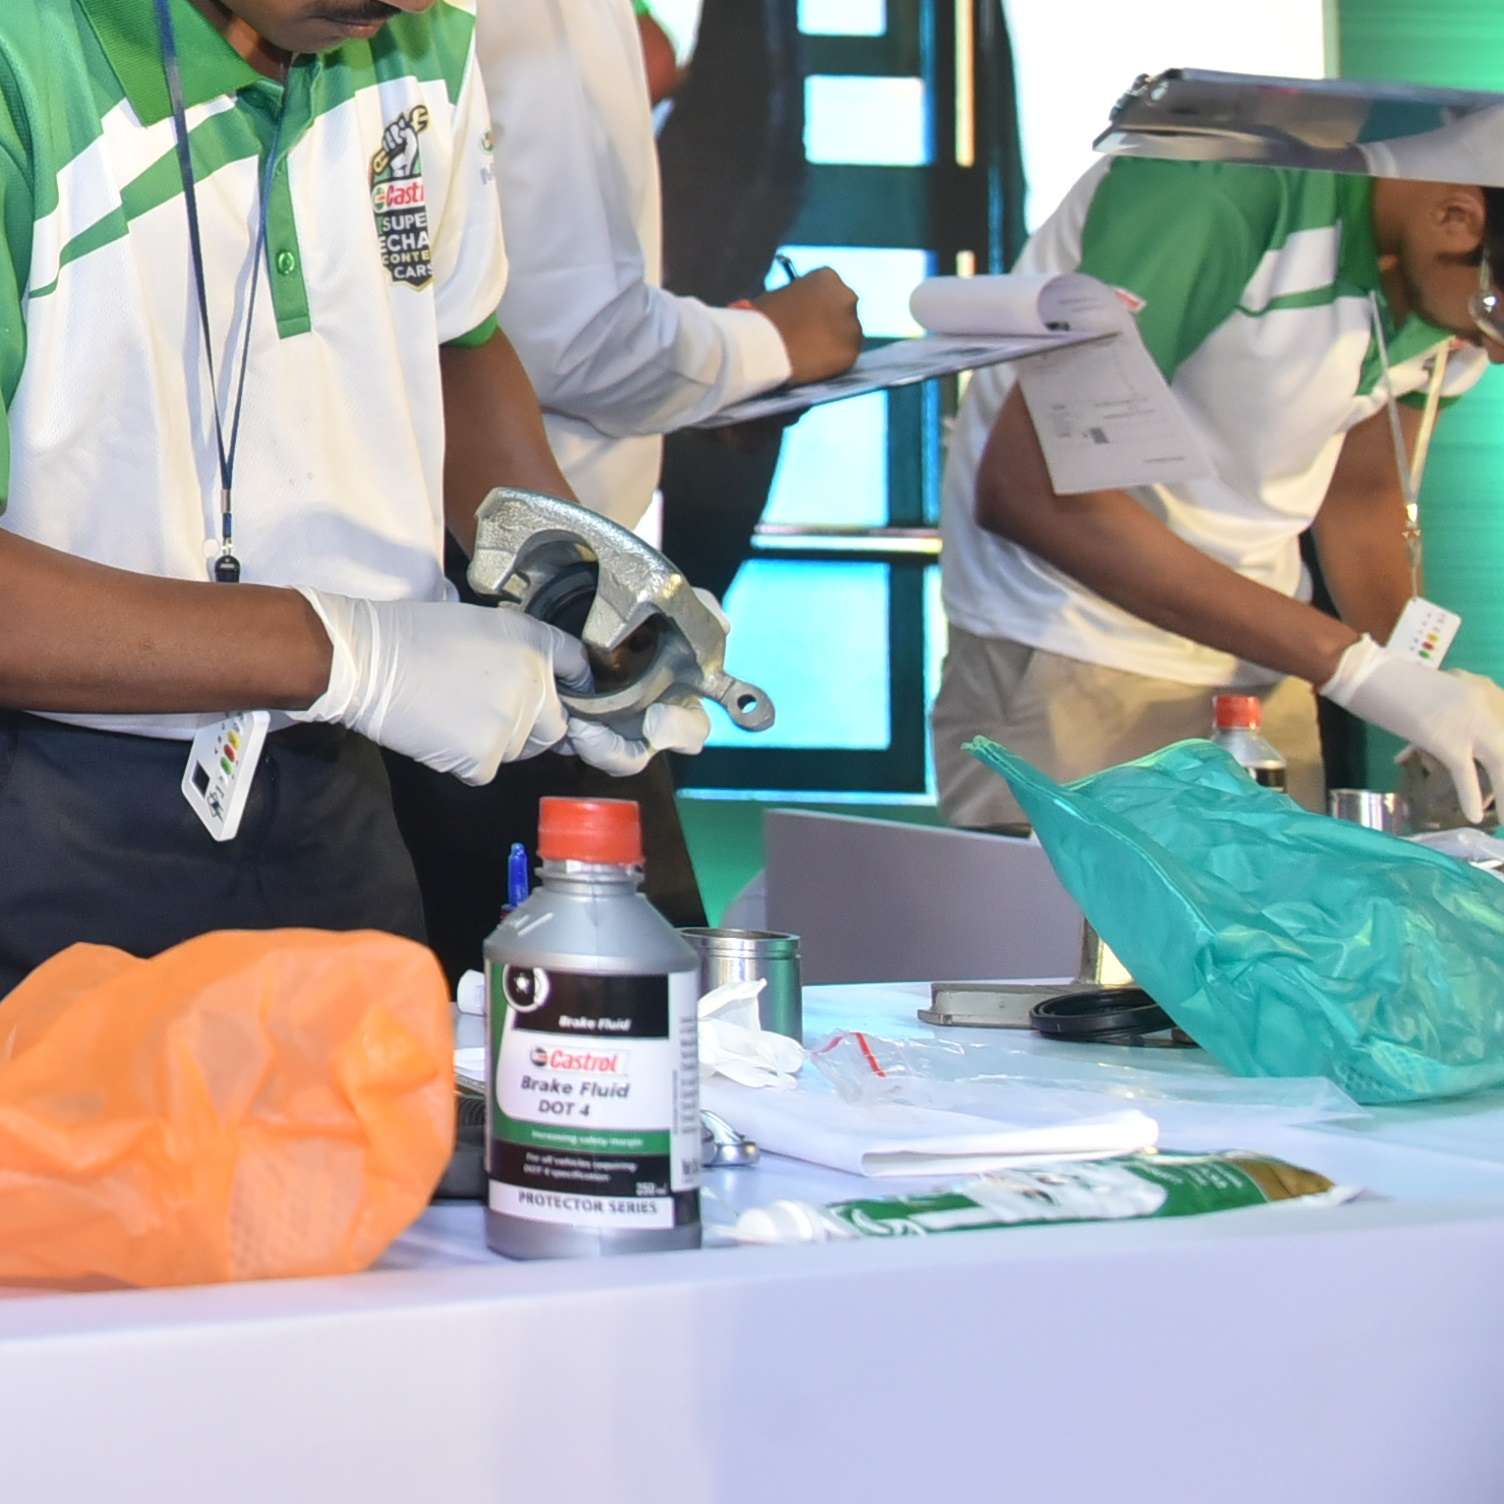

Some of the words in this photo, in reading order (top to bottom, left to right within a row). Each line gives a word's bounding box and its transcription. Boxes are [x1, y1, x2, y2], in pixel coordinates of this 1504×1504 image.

[383, 213, 426, 231] SUPE
[559, 1015, 594, 1029] Brake
[598, 1018, 631, 1031] Fluid
[550, 1049, 618, 1072] Castrol
[521, 1075, 573, 1094] Brake
[580, 1081, 630, 1098] Fluid
[538, 1099, 574, 1115] DOT
[580, 1104, 590, 1116] 4
[518, 1190, 603, 1212] PROTECTOR
[608, 1199, 657, 1213] SERIES
